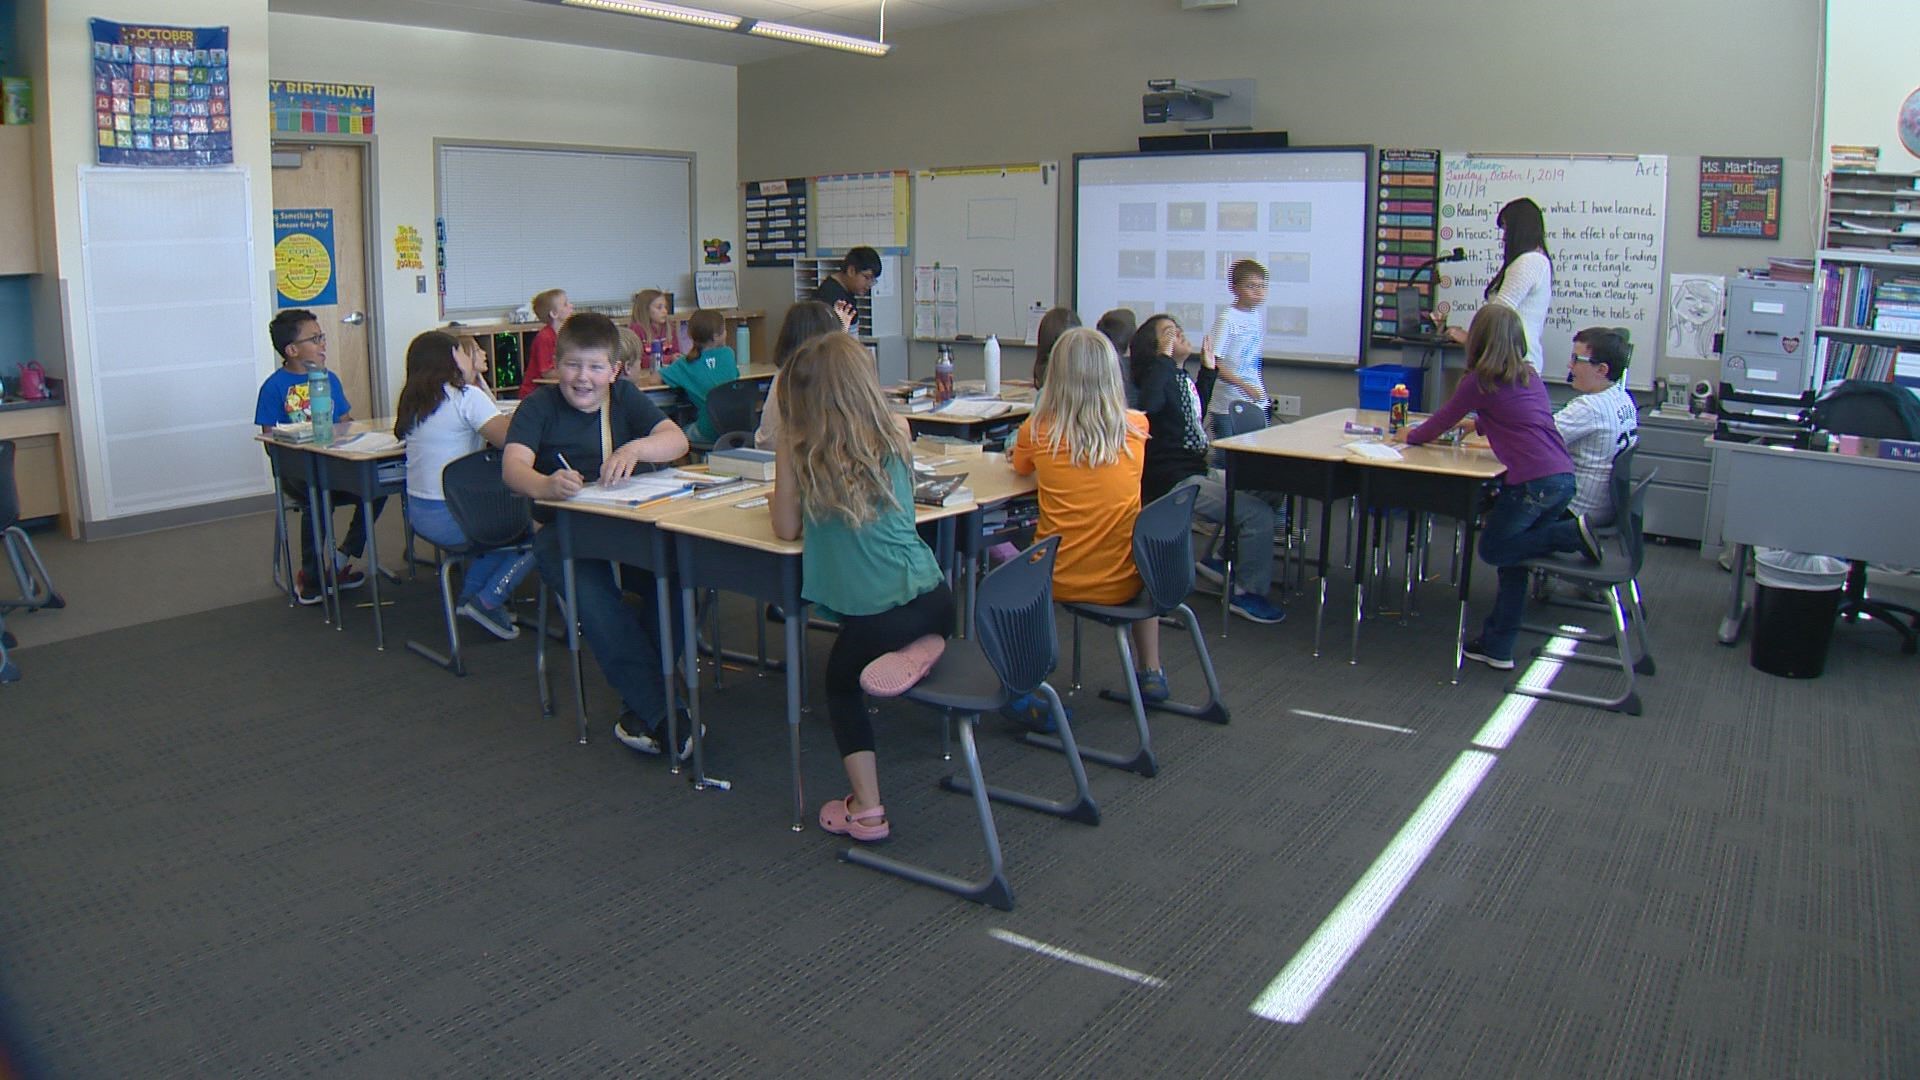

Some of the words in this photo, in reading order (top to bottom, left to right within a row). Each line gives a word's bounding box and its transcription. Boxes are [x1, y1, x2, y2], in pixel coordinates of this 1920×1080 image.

[137, 28, 193, 41] OCTOBER
[160, 69, 166, 78] 2
[196, 69, 203, 79] 4
[214, 69, 222, 79] 5
[214, 86, 225, 96] 12
[286, 82, 373, 99] BIRTHDAY!
[100, 98, 108, 108] 13
[157, 102, 167, 112] 16
[175, 102, 186, 112] 17
[213, 102, 223, 112] 19
[136, 120, 149, 130] 22
[156, 120, 168, 130] 23
[174, 120, 188, 130] 24
[213, 119, 228, 129] 26
[1636, 162, 1659, 176] Art
[1725, 160, 1779, 174] Martinez
[1490, 169, 1522, 180] October
[1537, 168, 1565, 181] 2019
[1445, 180, 1486, 198] 10/1/19
[1732, 183, 1754, 195] CREATE
[1457, 202, 1491, 221] Reading:
[1551, 201, 1576, 213] what
[1580, 200, 1587, 213] I
[1592, 200, 1615, 213] have
[1615, 200, 1656, 216] learned.
[1727, 200, 1740, 210] BE
[280, 211, 314, 221] Something
[1701, 200, 1713, 232] GROW
[300, 220, 315, 230] Every
[1562, 227, 1576, 239] the
[1580, 226, 1605, 239] effect
[1609, 226, 1622, 239] of
[1623, 231, 1654, 247] caring
[1559, 248, 1599, 261] formula
[1605, 248, 1619, 260] for
[1625, 247, 1657, 270] finding
[1556, 262, 1566, 272] of
[1572, 263, 1578, 272] a
[1565, 280, 1571, 288] a
[1574, 278, 1596, 290] topic
[1601, 278, 1620, 288] and
[1624, 281, 1654, 294] convey
[1551, 290, 1601, 298] nformation
[1452, 298, 1478, 311] Social
[1556, 304, 1588, 317] explore
[1593, 304, 1606, 318] the
[1610, 305, 1631, 319] tools
[1634, 308, 1646, 320] of
